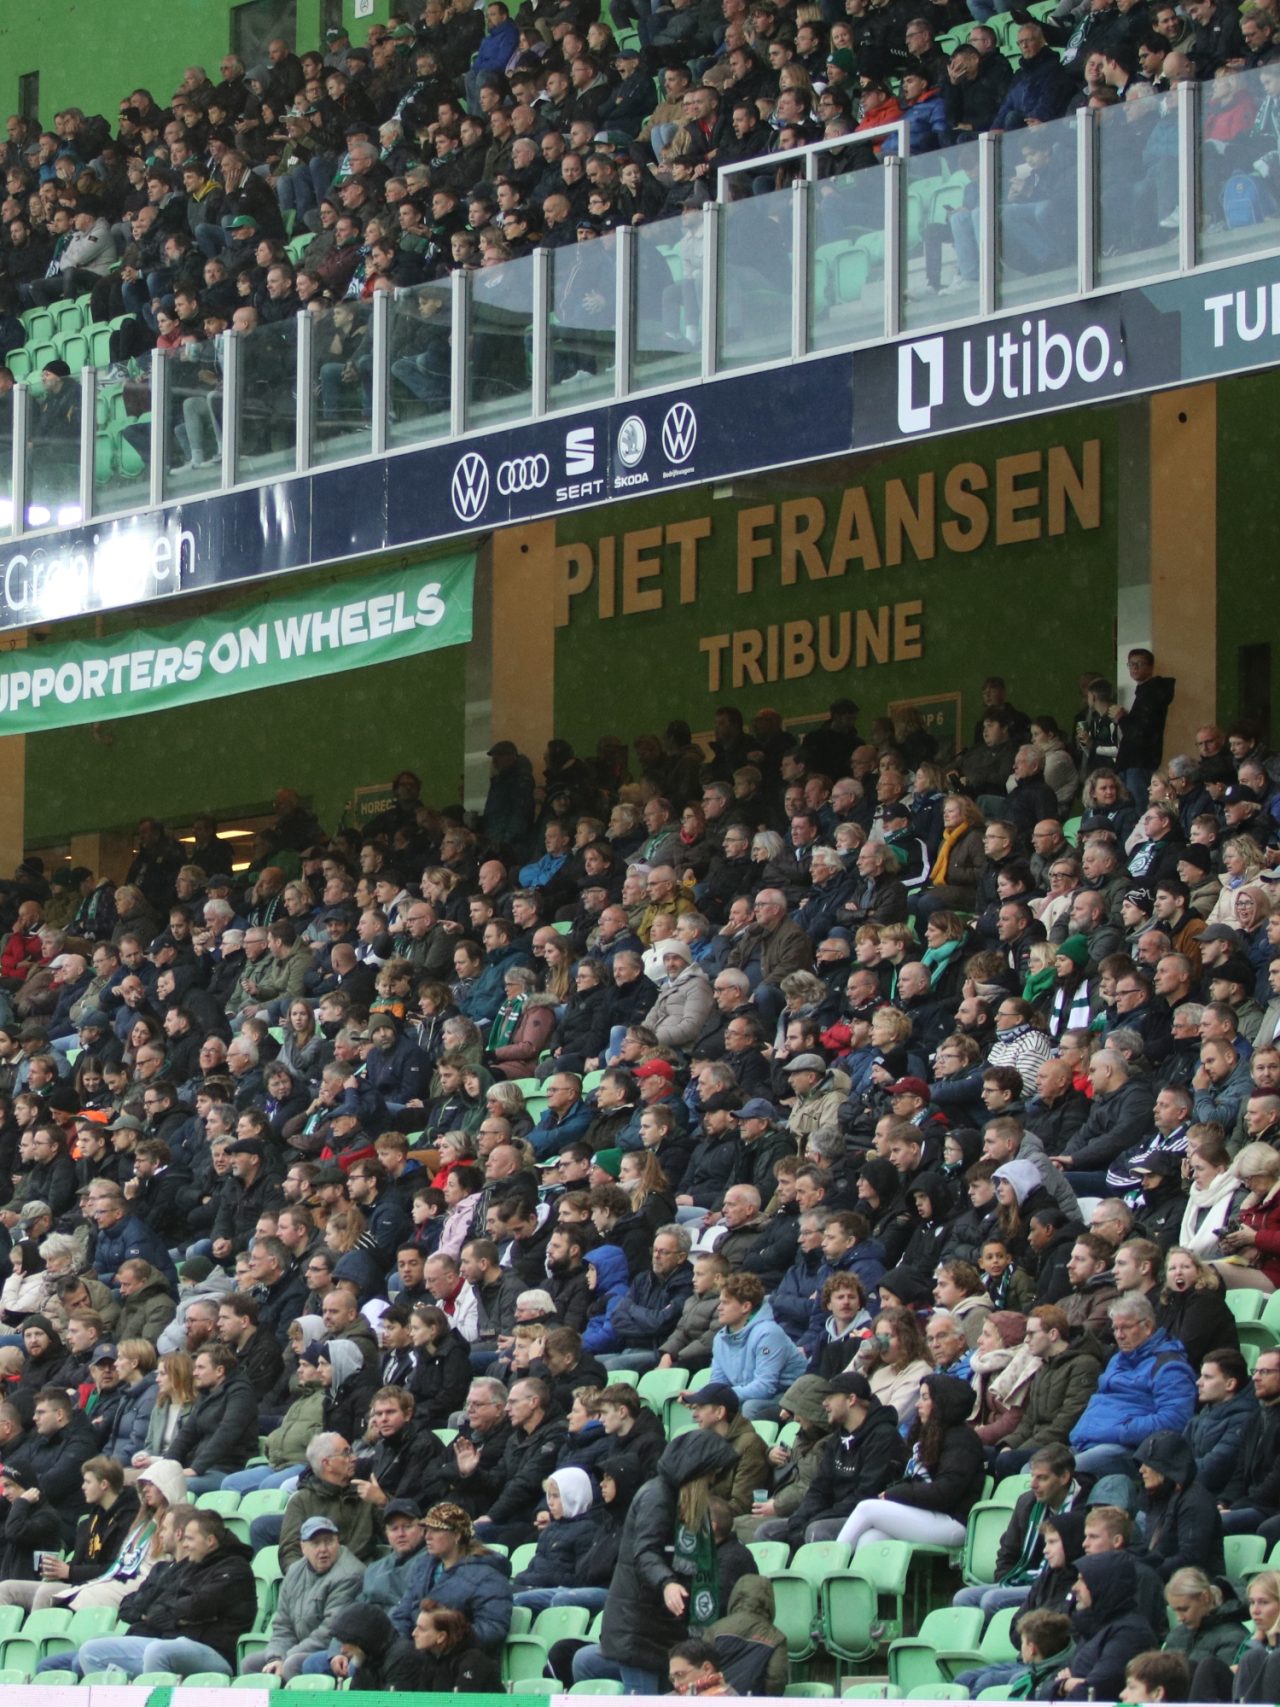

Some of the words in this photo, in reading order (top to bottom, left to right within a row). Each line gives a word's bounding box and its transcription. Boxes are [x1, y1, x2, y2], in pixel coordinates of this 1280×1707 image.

[963, 319, 1124, 407] Utibo.
[556, 479, 604, 502] SEAT
[614, 472, 649, 489] ŠKODA
[554, 516, 711, 628] PIET
[736, 438, 1101, 595] FRANSEN
[208, 623, 268, 675] ON
[273, 582, 446, 659] WHEELS
[699, 600, 923, 692] TRIBUNE
[360, 799, 395, 816] HOREC
